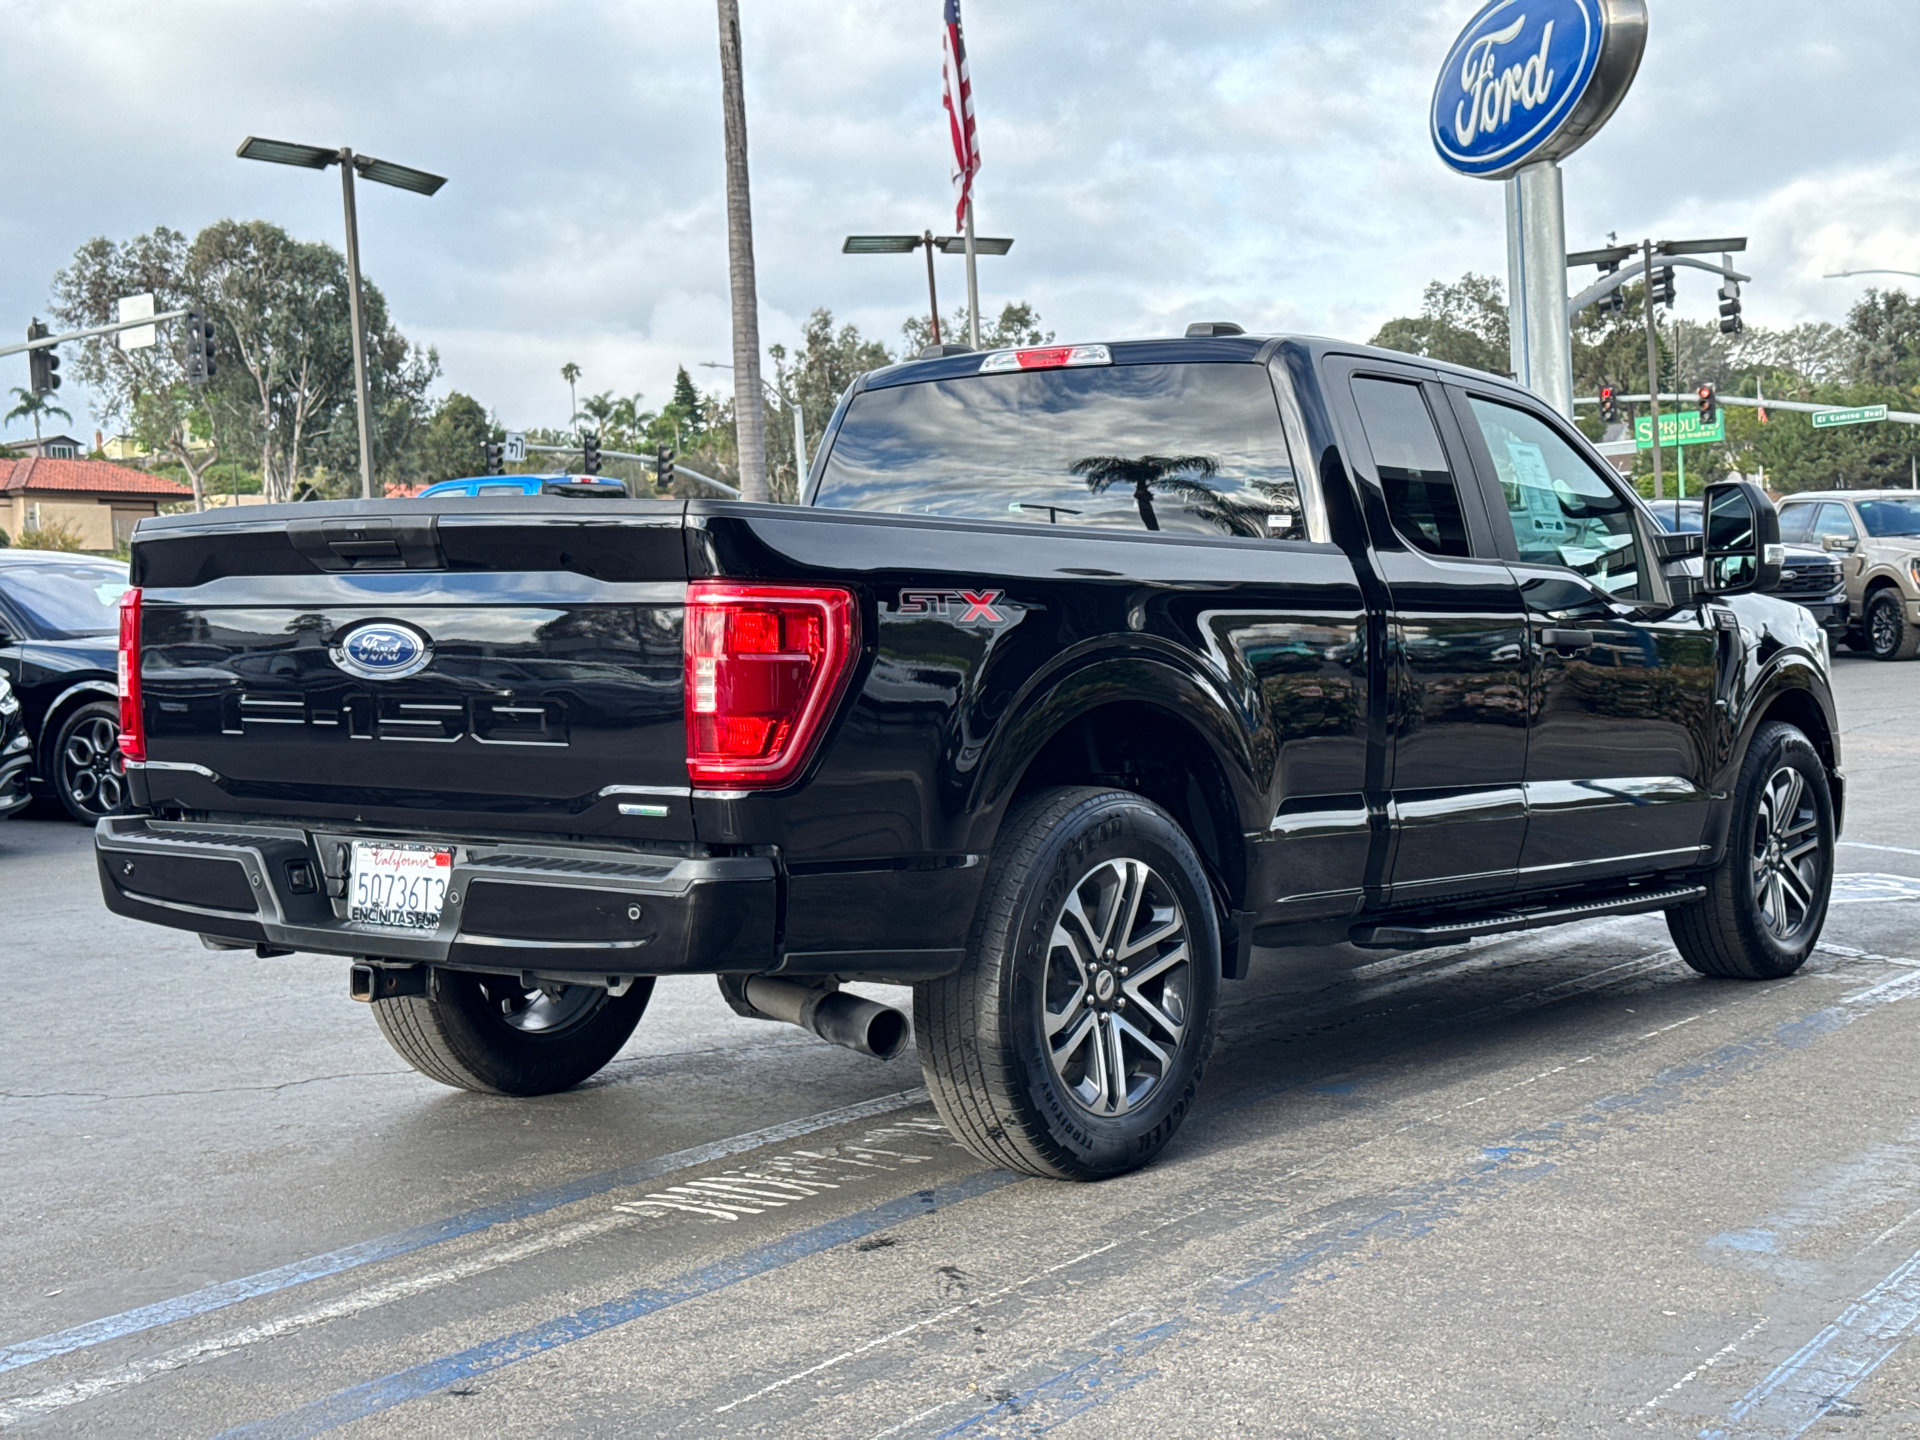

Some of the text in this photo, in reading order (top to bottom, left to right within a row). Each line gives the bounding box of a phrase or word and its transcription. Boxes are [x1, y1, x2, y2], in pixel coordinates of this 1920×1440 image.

[1454, 13, 1555, 147] Ford
[1816, 410, 1883, 423] El Camino Real
[896, 588, 1009, 628] STX
[358, 633, 402, 661] Ford
[220, 690, 571, 747] F-150
[373, 850, 436, 872] California
[1040, 1082, 1095, 1150] TERRITORY
